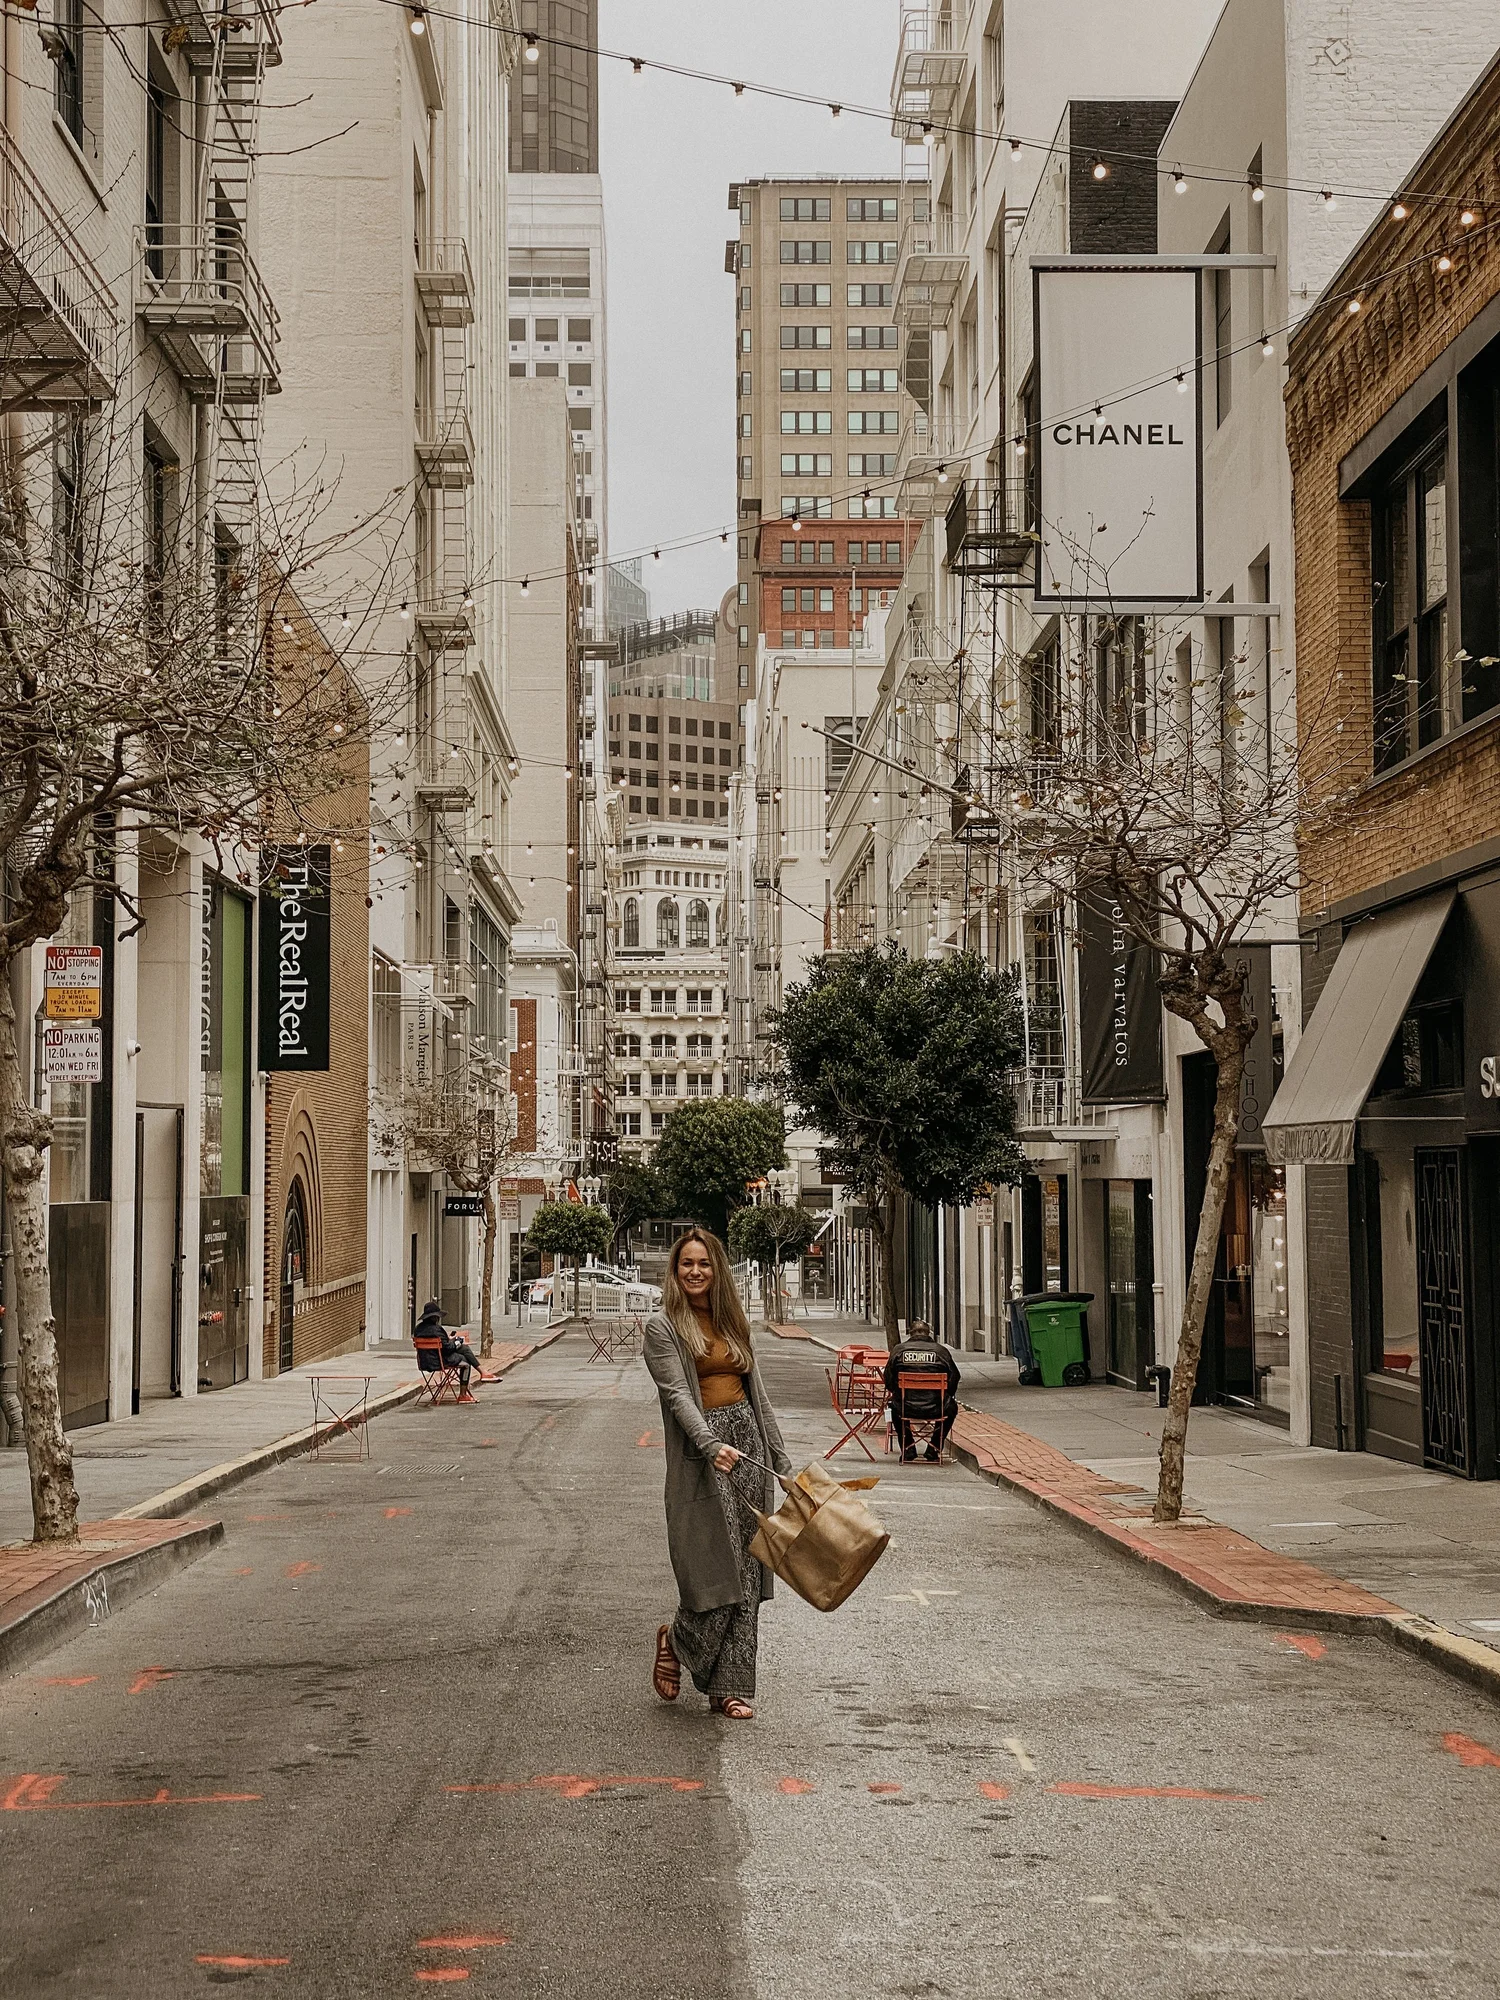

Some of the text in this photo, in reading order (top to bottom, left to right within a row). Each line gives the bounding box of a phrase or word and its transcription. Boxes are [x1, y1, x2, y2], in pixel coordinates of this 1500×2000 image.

[1053, 424, 1183, 445] CHANEL
[48, 956, 99, 969] NO STOPPING
[279, 858, 308, 1057] TheRealReal
[80, 972, 97, 980] 6PM
[1113, 963, 1129, 1066] varvatos
[46, 1031, 99, 1045] NO PARKING
[407, 1022, 415, 1051] PARIS
[48, 1062, 99, 1071] MON WED FRI
[1241, 1060, 1259, 1132] CHOO
[904, 1352, 934, 1362] SECURITY
